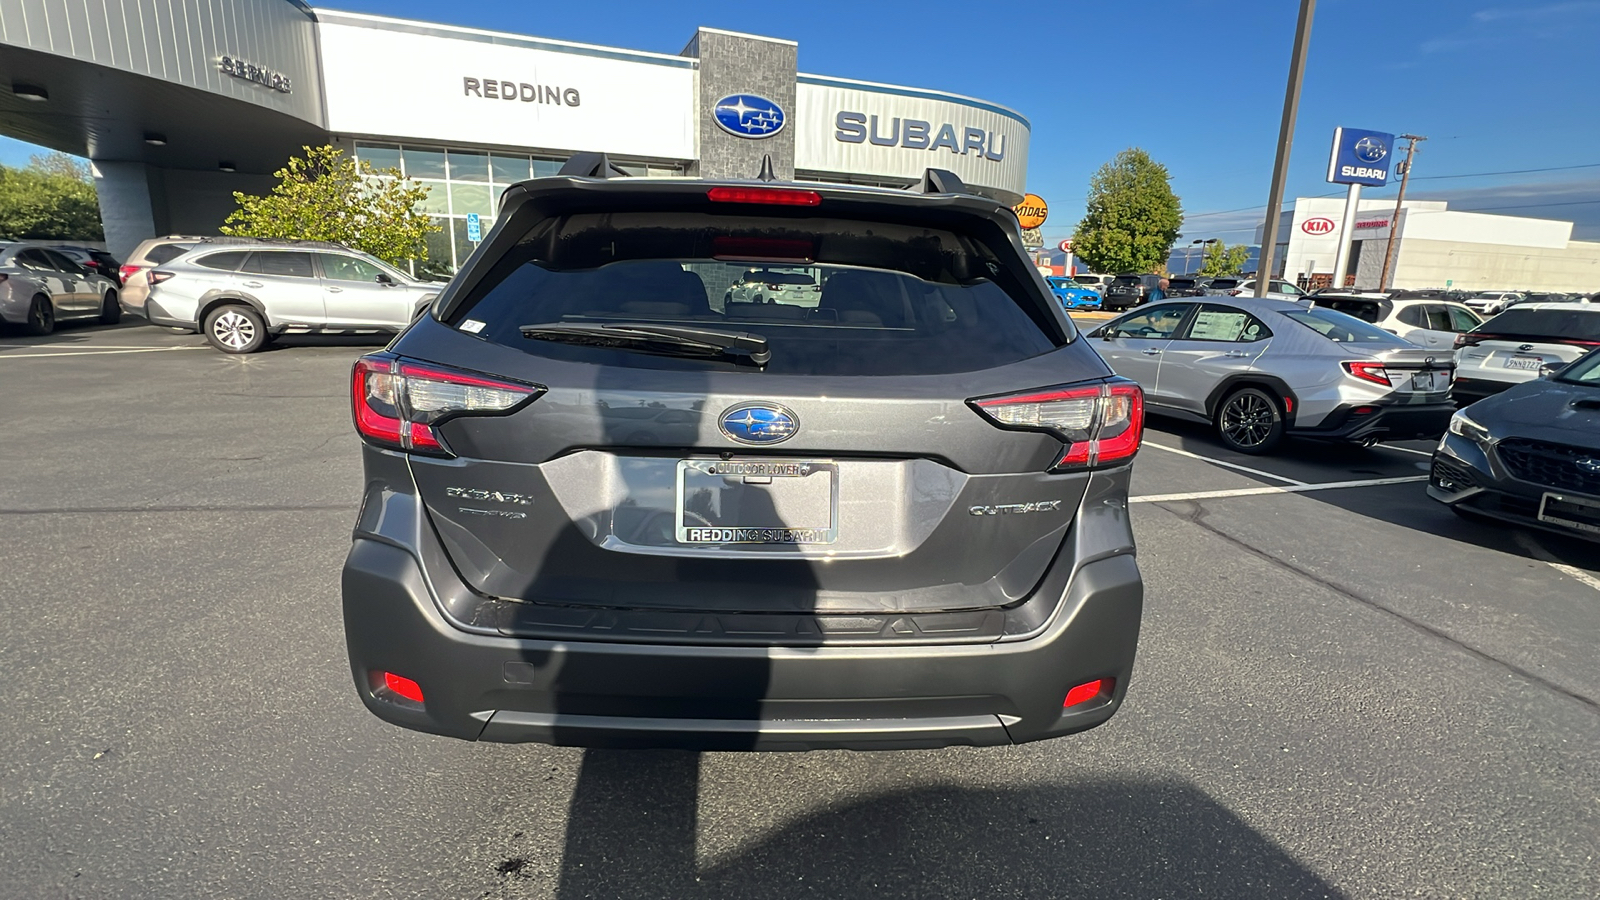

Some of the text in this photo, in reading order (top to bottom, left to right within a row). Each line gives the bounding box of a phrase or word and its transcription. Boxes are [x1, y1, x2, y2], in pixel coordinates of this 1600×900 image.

[220, 56, 292, 94] SERVICE
[463, 76, 581, 107] REDDING
[835, 110, 1006, 162] SUBARU
[1341, 165, 1387, 180] SUBARU
[1014, 206, 1047, 218] MIDAS
[1307, 221, 1329, 231] KIA
[717, 462, 799, 475] OUTDOOR LOVER
[969, 500, 1061, 515] OUTBACK
[690, 529, 828, 542] REDDING SUBARU
